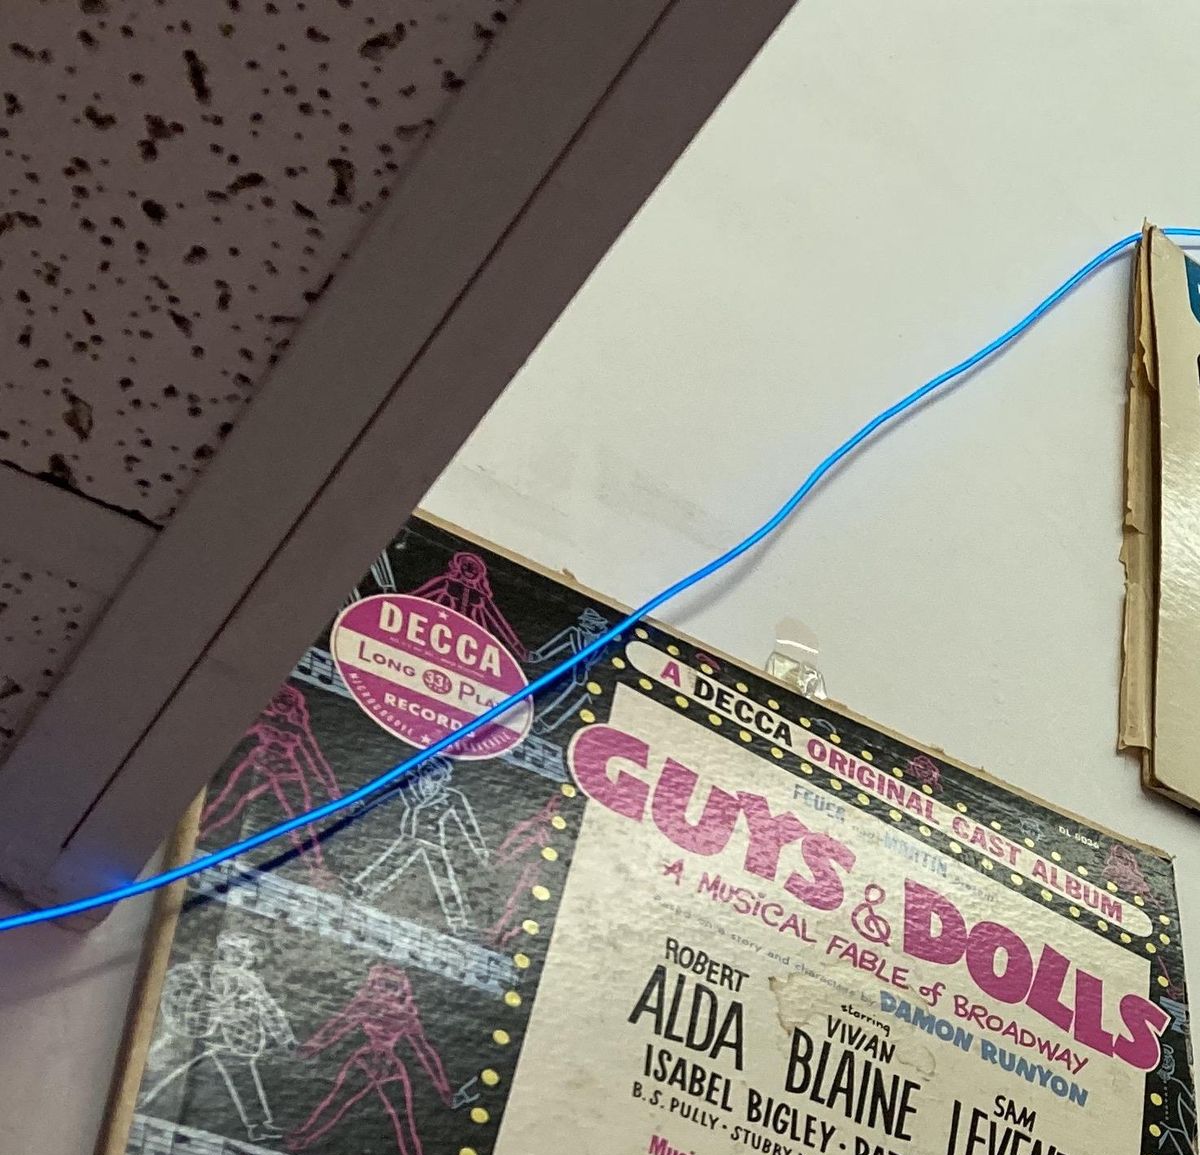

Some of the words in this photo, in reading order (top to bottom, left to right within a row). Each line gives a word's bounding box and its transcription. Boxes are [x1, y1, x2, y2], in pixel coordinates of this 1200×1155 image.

[379, 601, 502, 677] DECCA
[384, 692, 476, 738] RECORD
[660, 661, 681, 688] A
[694, 674, 792, 747] DECCA
[807, 738, 940, 826] ORIGINAL
[951, 816, 1021, 866] CAST
[1032, 860, 1123, 924] ALBUM
[570, 725, 857, 912] GUYS
[851, 884, 891, 947] &
[903, 878, 1170, 1071] DOLLS
[661, 859, 684, 887] A
[826, 935, 909, 990] FABLE
[919, 982, 946, 1007] of
[954, 995, 1088, 1075] BROADWAY
[665, 937, 750, 993] ROBERT
[627, 964, 743, 1072] ALDA
[827, 1014, 896, 1064] VIVIAN
[841, 1004, 891, 1037] starring
[880, 990, 974, 1052] DAMON
[980, 1038, 1088, 1108] RUNYON
[644, 1044, 732, 1112] ISABEL
[746, 1088, 836, 1154] BIGLEY
[669, 1097, 719, 1131] PULLY
[785, 1026, 921, 1142] BLAINE
[993, 1095, 1036, 1132] SAM
